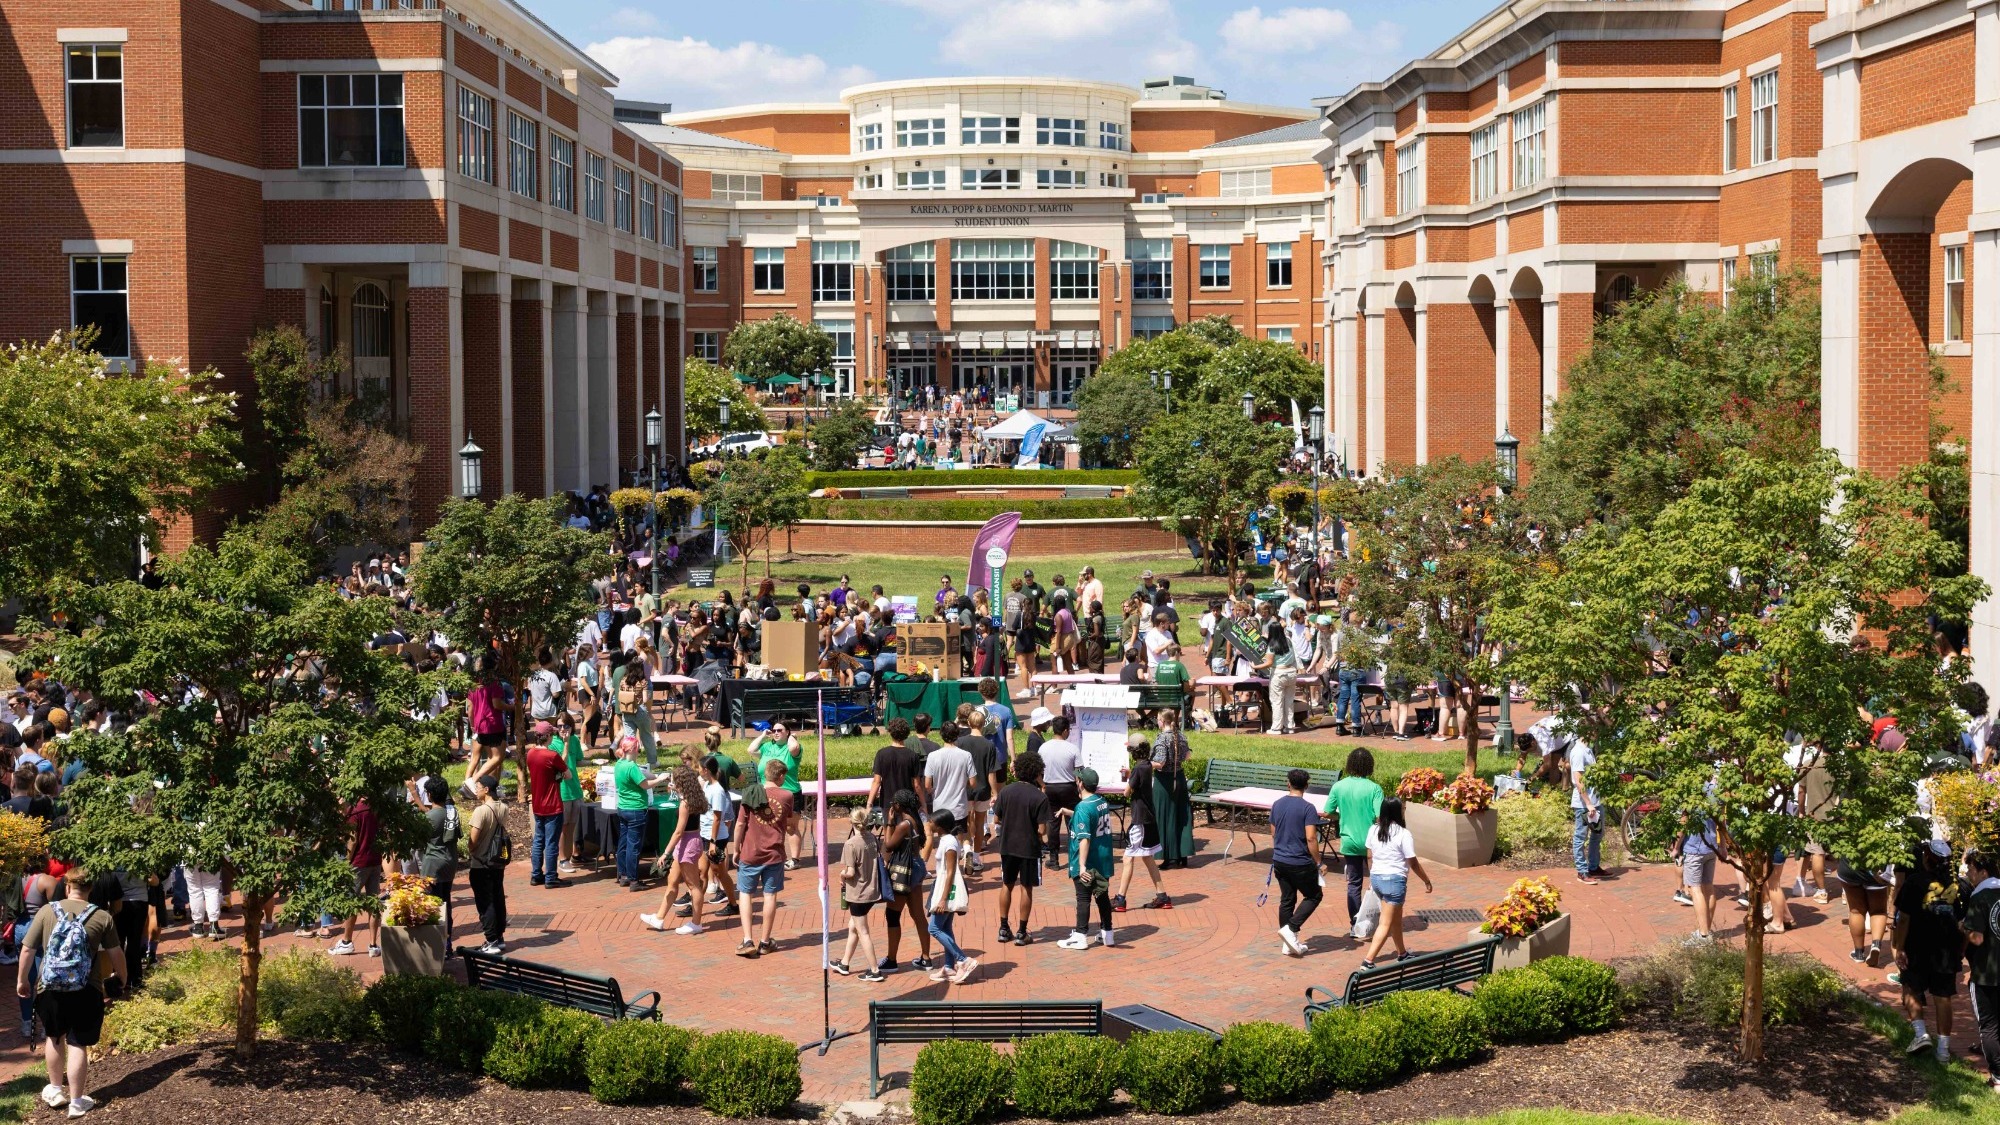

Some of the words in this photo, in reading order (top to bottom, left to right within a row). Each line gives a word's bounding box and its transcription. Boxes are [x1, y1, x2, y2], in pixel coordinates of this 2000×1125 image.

[910, 205, 940, 214] KAREN
[942, 205, 950, 214] A.
[952, 205, 975, 214] POPP
[976, 205, 984, 213] &
[985, 204, 1026, 213] DEMOND
[1028, 204, 1036, 213] T.
[1038, 203, 1074, 212] MARTIN
[954, 217, 997, 226] STUDENT
[1000, 217, 1030, 226] UNION
[1096, 813, 1111, 837] 23
